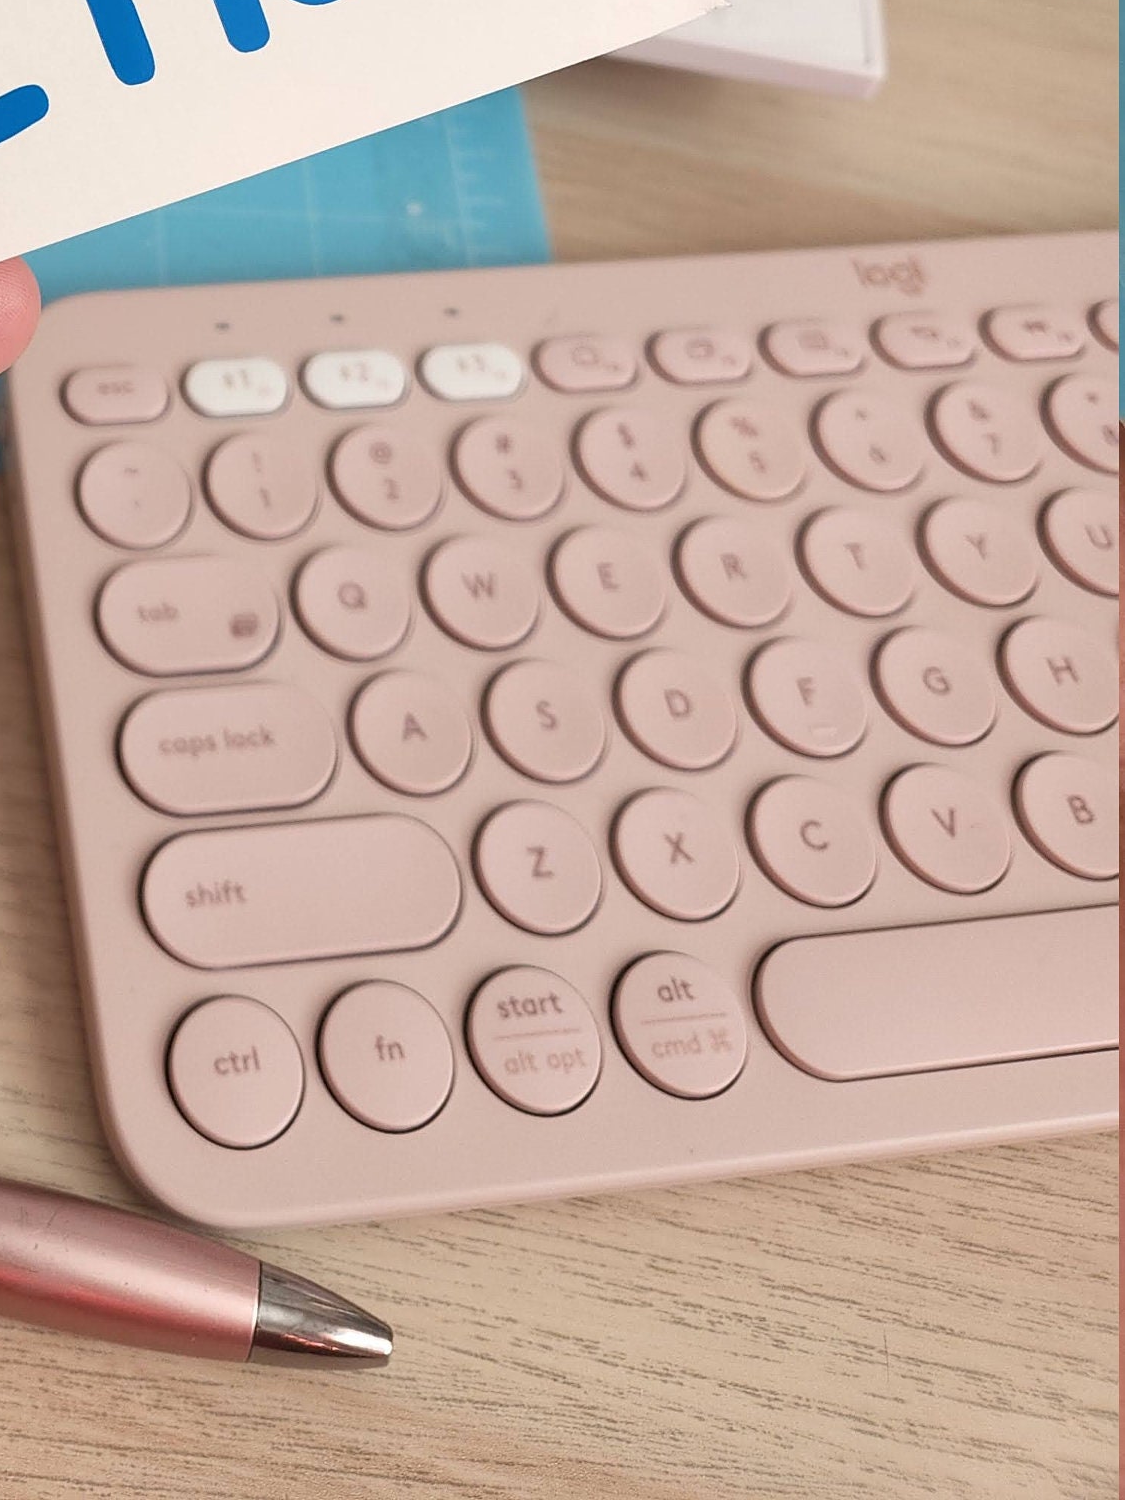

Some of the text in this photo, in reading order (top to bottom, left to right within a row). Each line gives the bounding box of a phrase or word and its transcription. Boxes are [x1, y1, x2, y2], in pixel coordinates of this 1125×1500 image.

[965, 533, 990, 560] Y
[1083, 523, 1114, 552] U
[719, 552, 748, 581] R
[844, 540, 867, 571] T
[461, 570, 496, 601] W
[597, 561, 622, 592] E
[337, 580, 368, 611] Q
[136, 602, 180, 623] tab
[922, 665, 952, 696] G
[1046, 654, 1082, 686] H
[664, 688, 693, 720] D
[795, 675, 819, 707] F
[401, 710, 429, 743] A
[536, 700, 560, 732] S
[158, 724, 276, 759] caps lock
[930, 806, 958, 840] V
[1065, 794, 1097, 827] B
[661, 830, 694, 865] X
[798, 817, 831, 852] C
[525, 845, 555, 880] Z
[185, 879, 247, 909] shift
[656, 975, 695, 1004] alt
[495, 991, 564, 1020] start
[212, 1044, 263, 1077] ctrl
[374, 1033, 406, 1062] fn
[503, 1045, 588, 1076] alt opt
[650, 1033, 701, 1060] cmd
